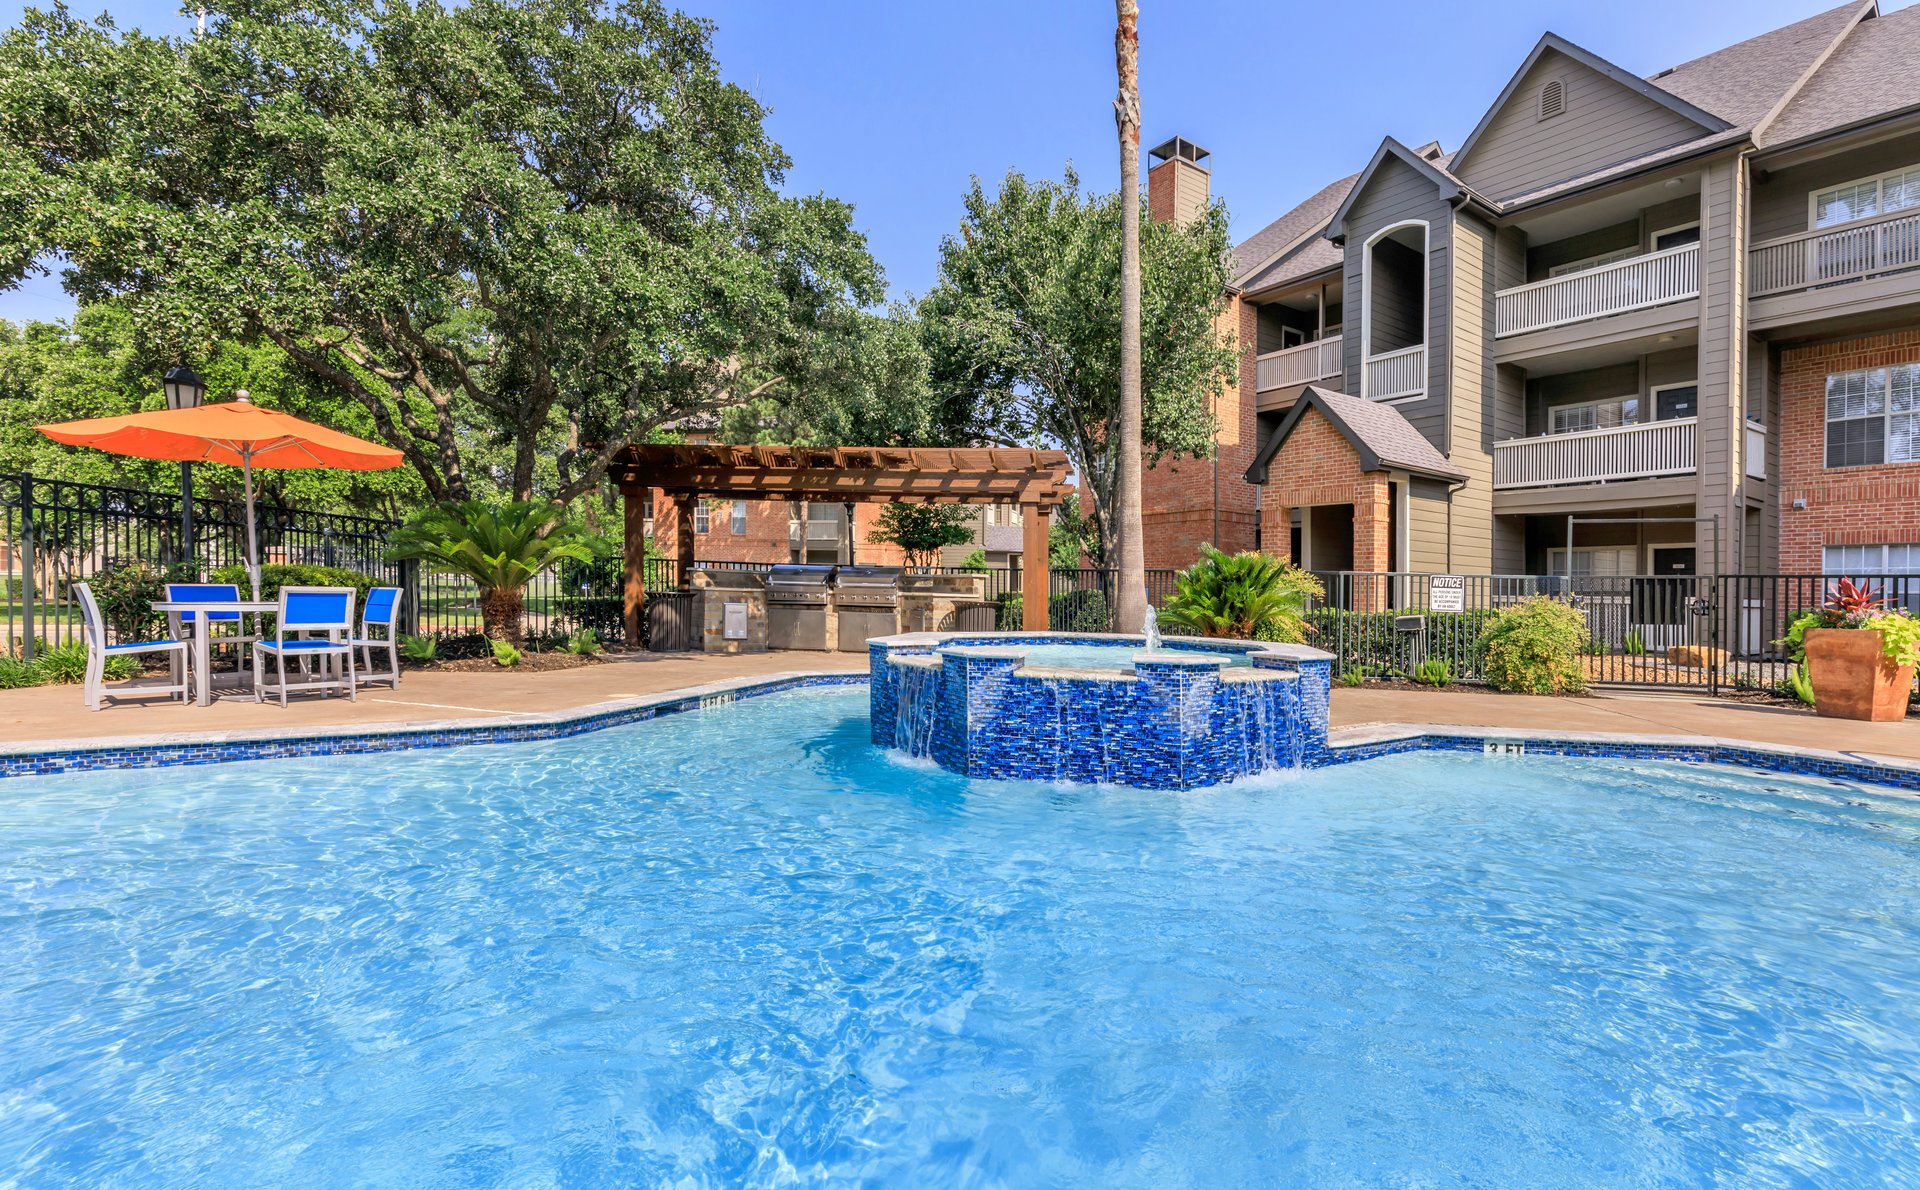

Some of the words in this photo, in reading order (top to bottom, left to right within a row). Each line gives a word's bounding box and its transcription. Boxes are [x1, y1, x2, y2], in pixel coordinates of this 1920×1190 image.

[1433, 578, 1462, 587] NOTICE
[702, 698, 707, 708] 3
[1489, 743, 1498, 752] 3
[1506, 744, 1523, 753] FT
